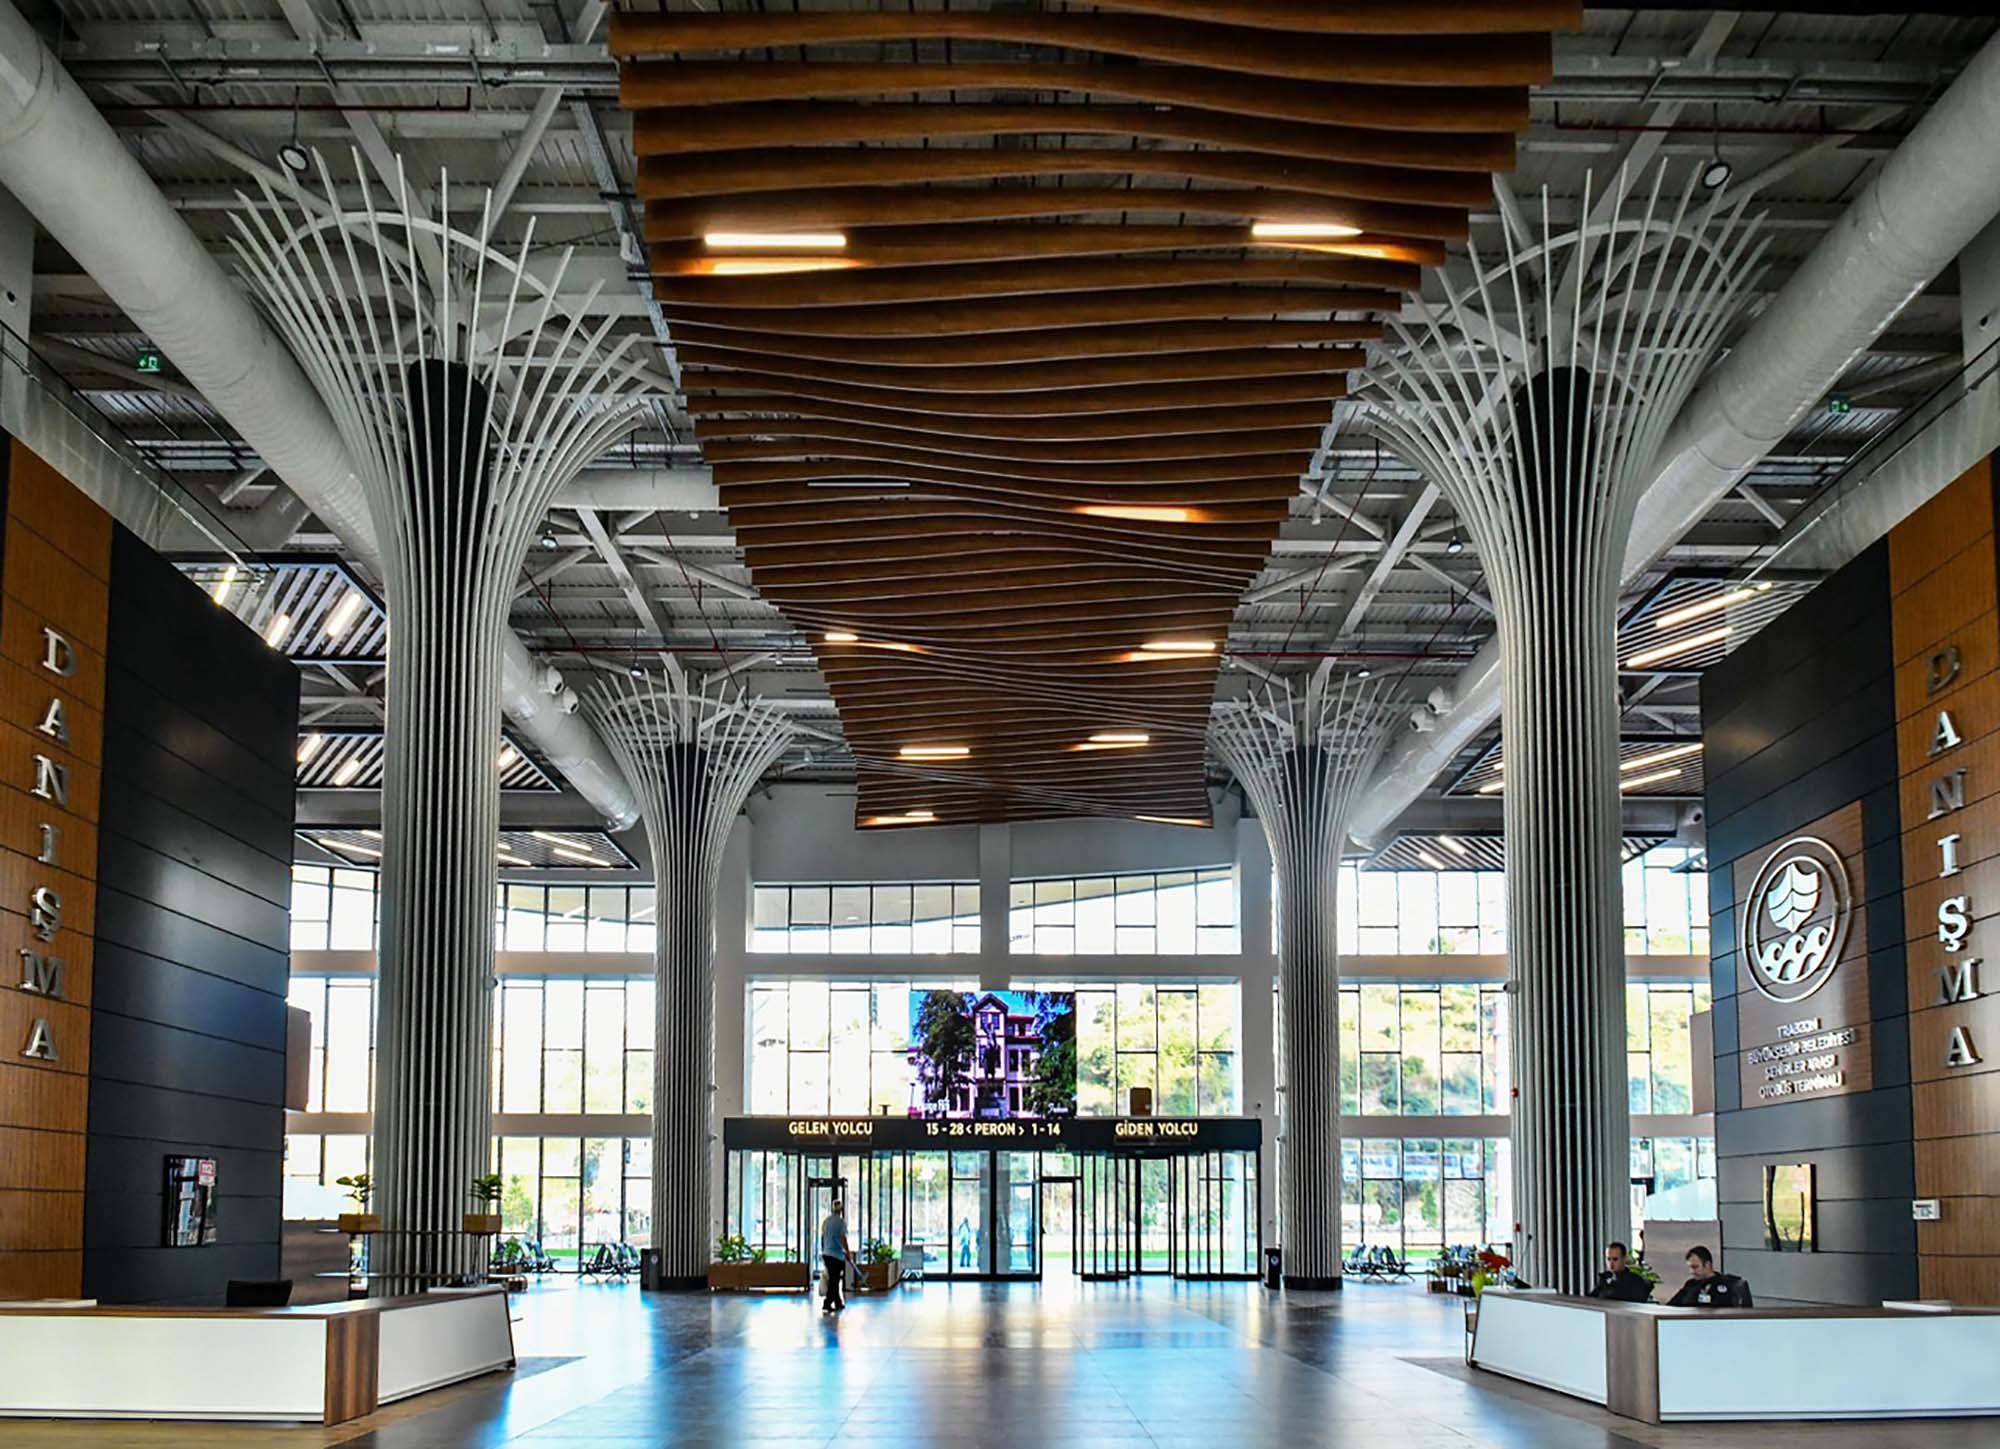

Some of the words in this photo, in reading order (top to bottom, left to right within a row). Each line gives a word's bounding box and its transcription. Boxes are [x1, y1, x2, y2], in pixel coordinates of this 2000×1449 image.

[18, 627, 76, 1062] DANIŞMA
[1926, 643, 1984, 1067] DANIŞMA
[788, 1121, 829, 1135] GELEN
[832, 1121, 873, 1135] YOLCU
[926, 1122, 939, 1136] 15
[949, 1122, 964, 1136] 28
[974, 1122, 1016, 1136] PERON
[1115, 1119, 1154, 1136] GİDEN
[1157, 1122, 1198, 1136] YOLCU
